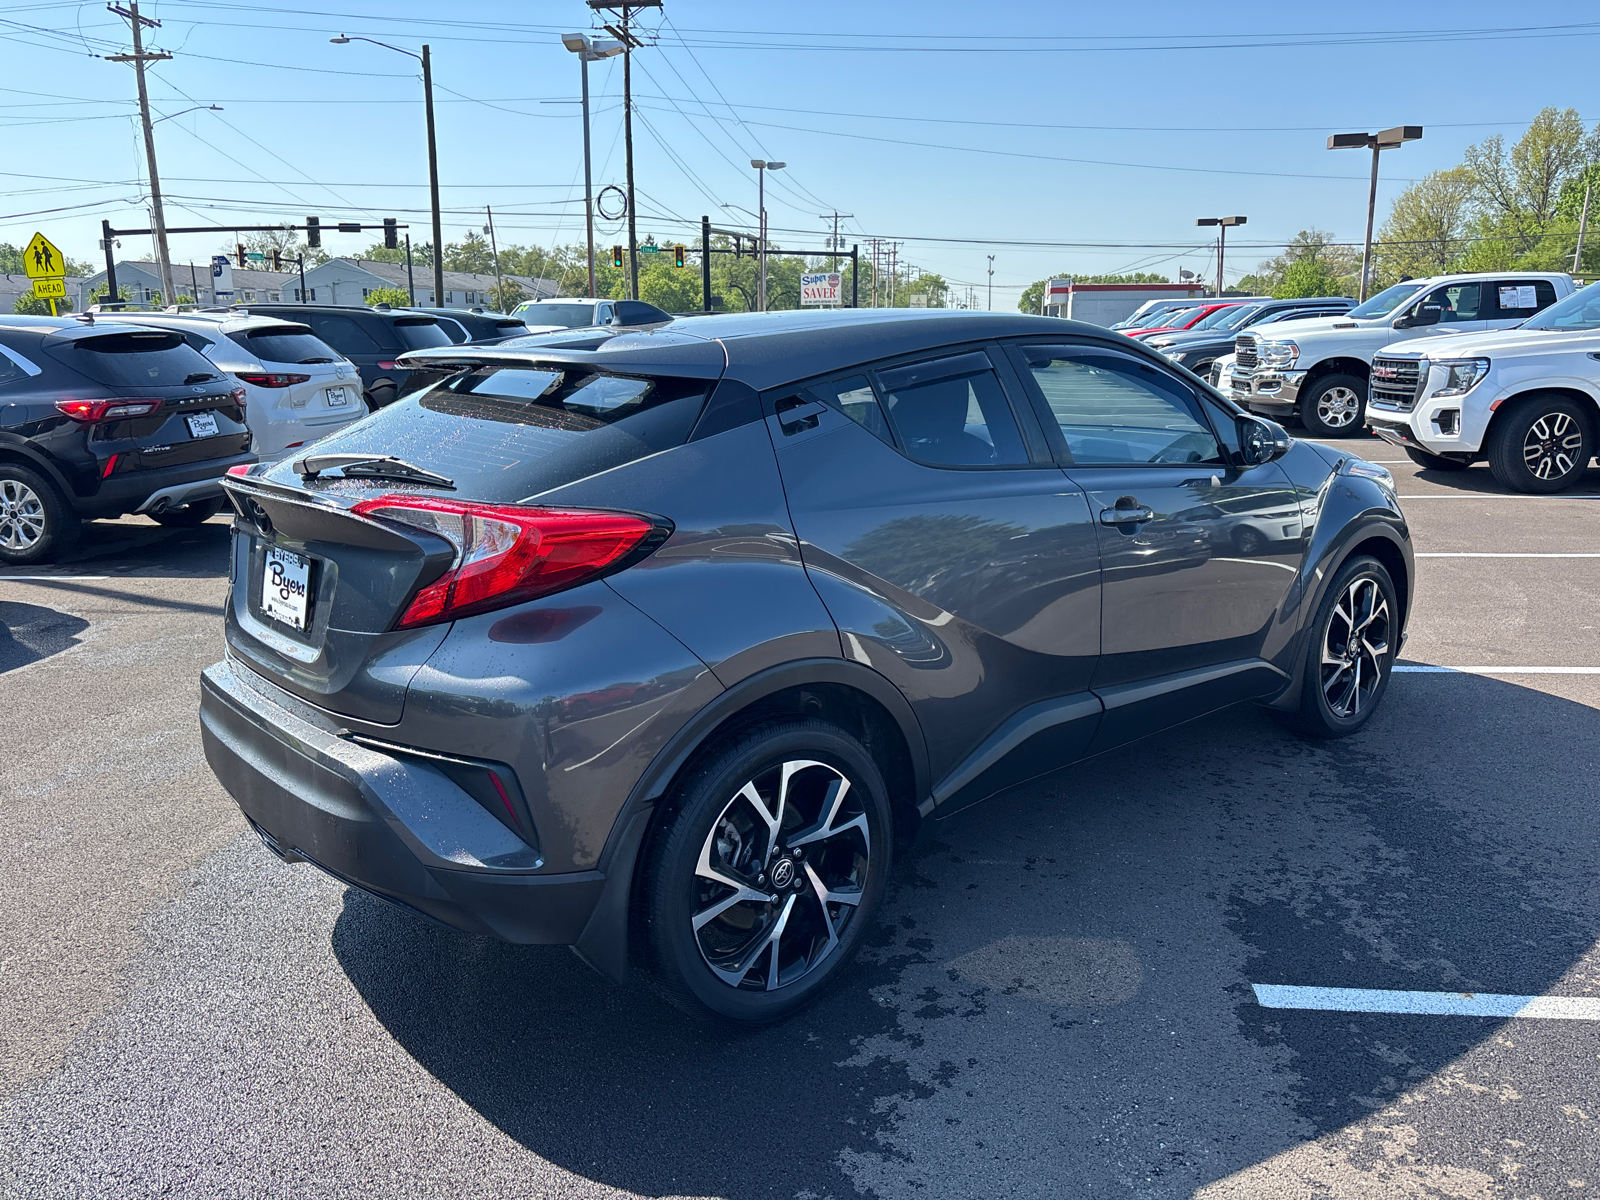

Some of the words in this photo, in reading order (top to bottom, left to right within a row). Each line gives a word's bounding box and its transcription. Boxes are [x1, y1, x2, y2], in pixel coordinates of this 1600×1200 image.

[802, 275, 827, 286] Super
[38, 283, 62, 294] AHEAD
[803, 287, 836, 299] SAVER
[191, 419, 215, 431] Byers
[274, 547, 299, 567] BYERS
[269, 561, 305, 601] Byers
